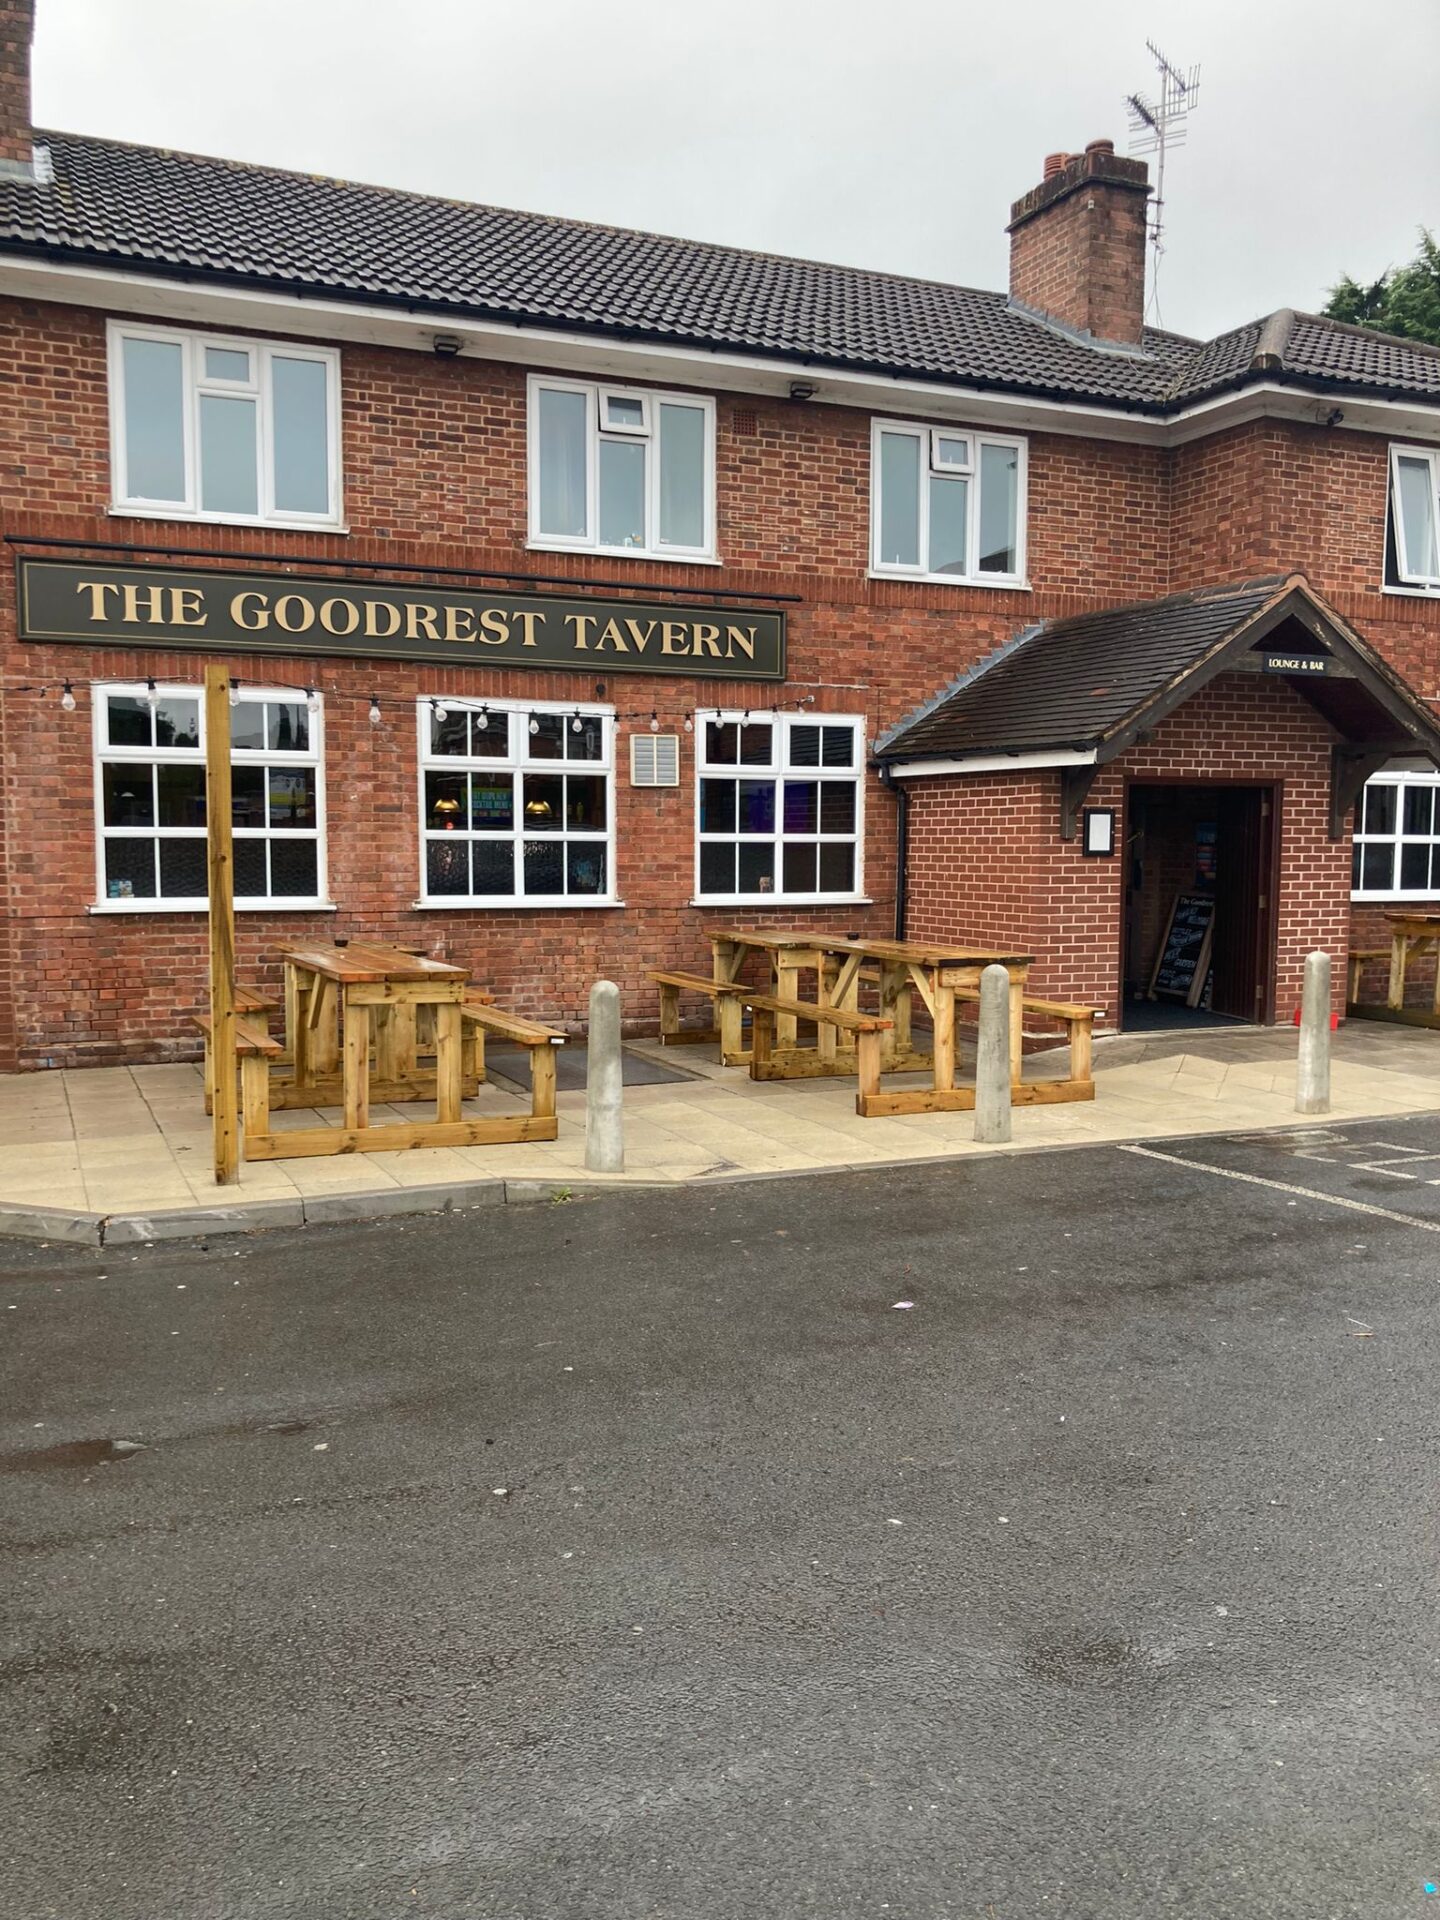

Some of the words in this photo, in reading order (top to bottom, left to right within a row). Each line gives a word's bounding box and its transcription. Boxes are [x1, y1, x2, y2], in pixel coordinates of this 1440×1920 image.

[77, 582, 208, 626] THE
[230, 592, 547, 647] GOODREST
[564, 615, 758, 660] TAVERN
[1268, 658, 1300, 669] LOUNGE
[1301, 661, 1308, 669] &
[1309, 661, 1324, 670] BAR
